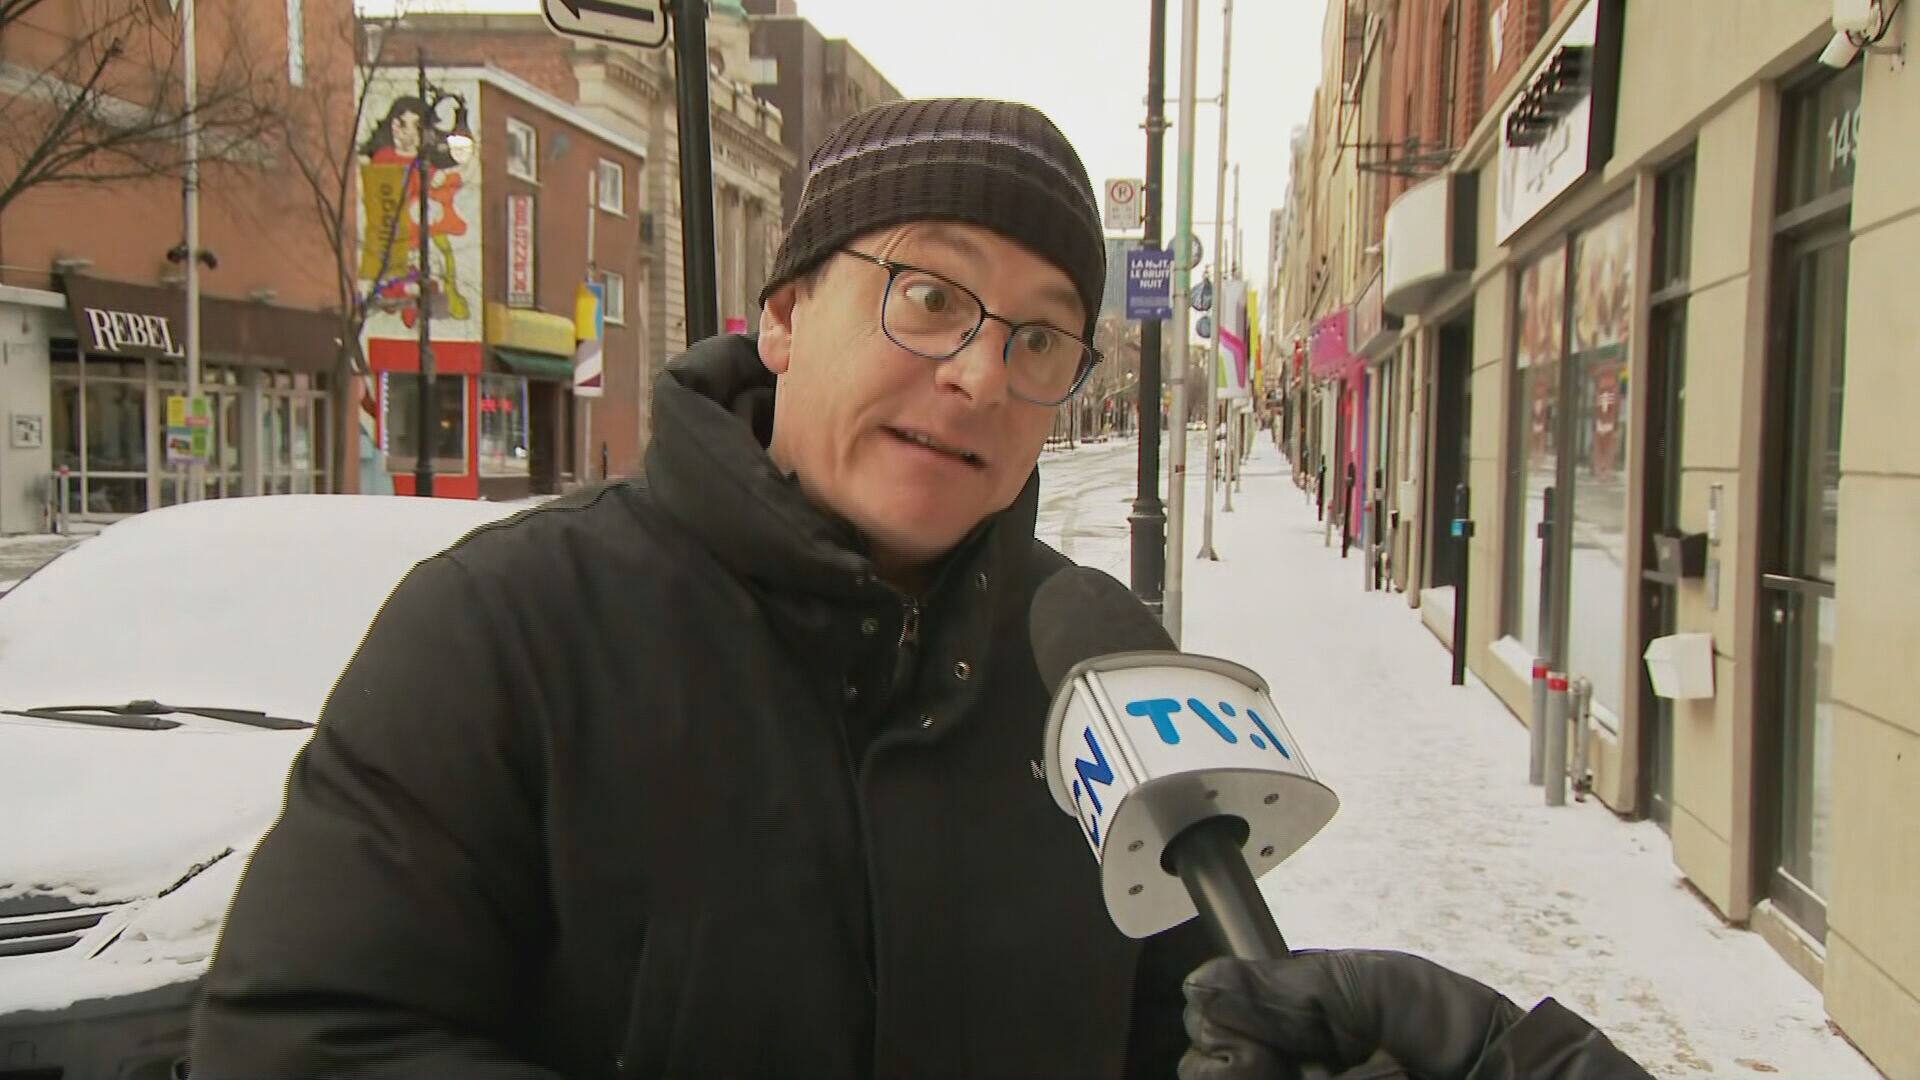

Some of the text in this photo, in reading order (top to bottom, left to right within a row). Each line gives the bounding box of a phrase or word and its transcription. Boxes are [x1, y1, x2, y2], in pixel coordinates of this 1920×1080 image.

[1131, 259, 1144, 269] LA
[1130, 269, 1169, 279] LE BRUIT
[1139, 279, 1162, 289] NUIT
[84, 307, 185, 358] REBEL
[1125, 698, 1290, 760] TVA
